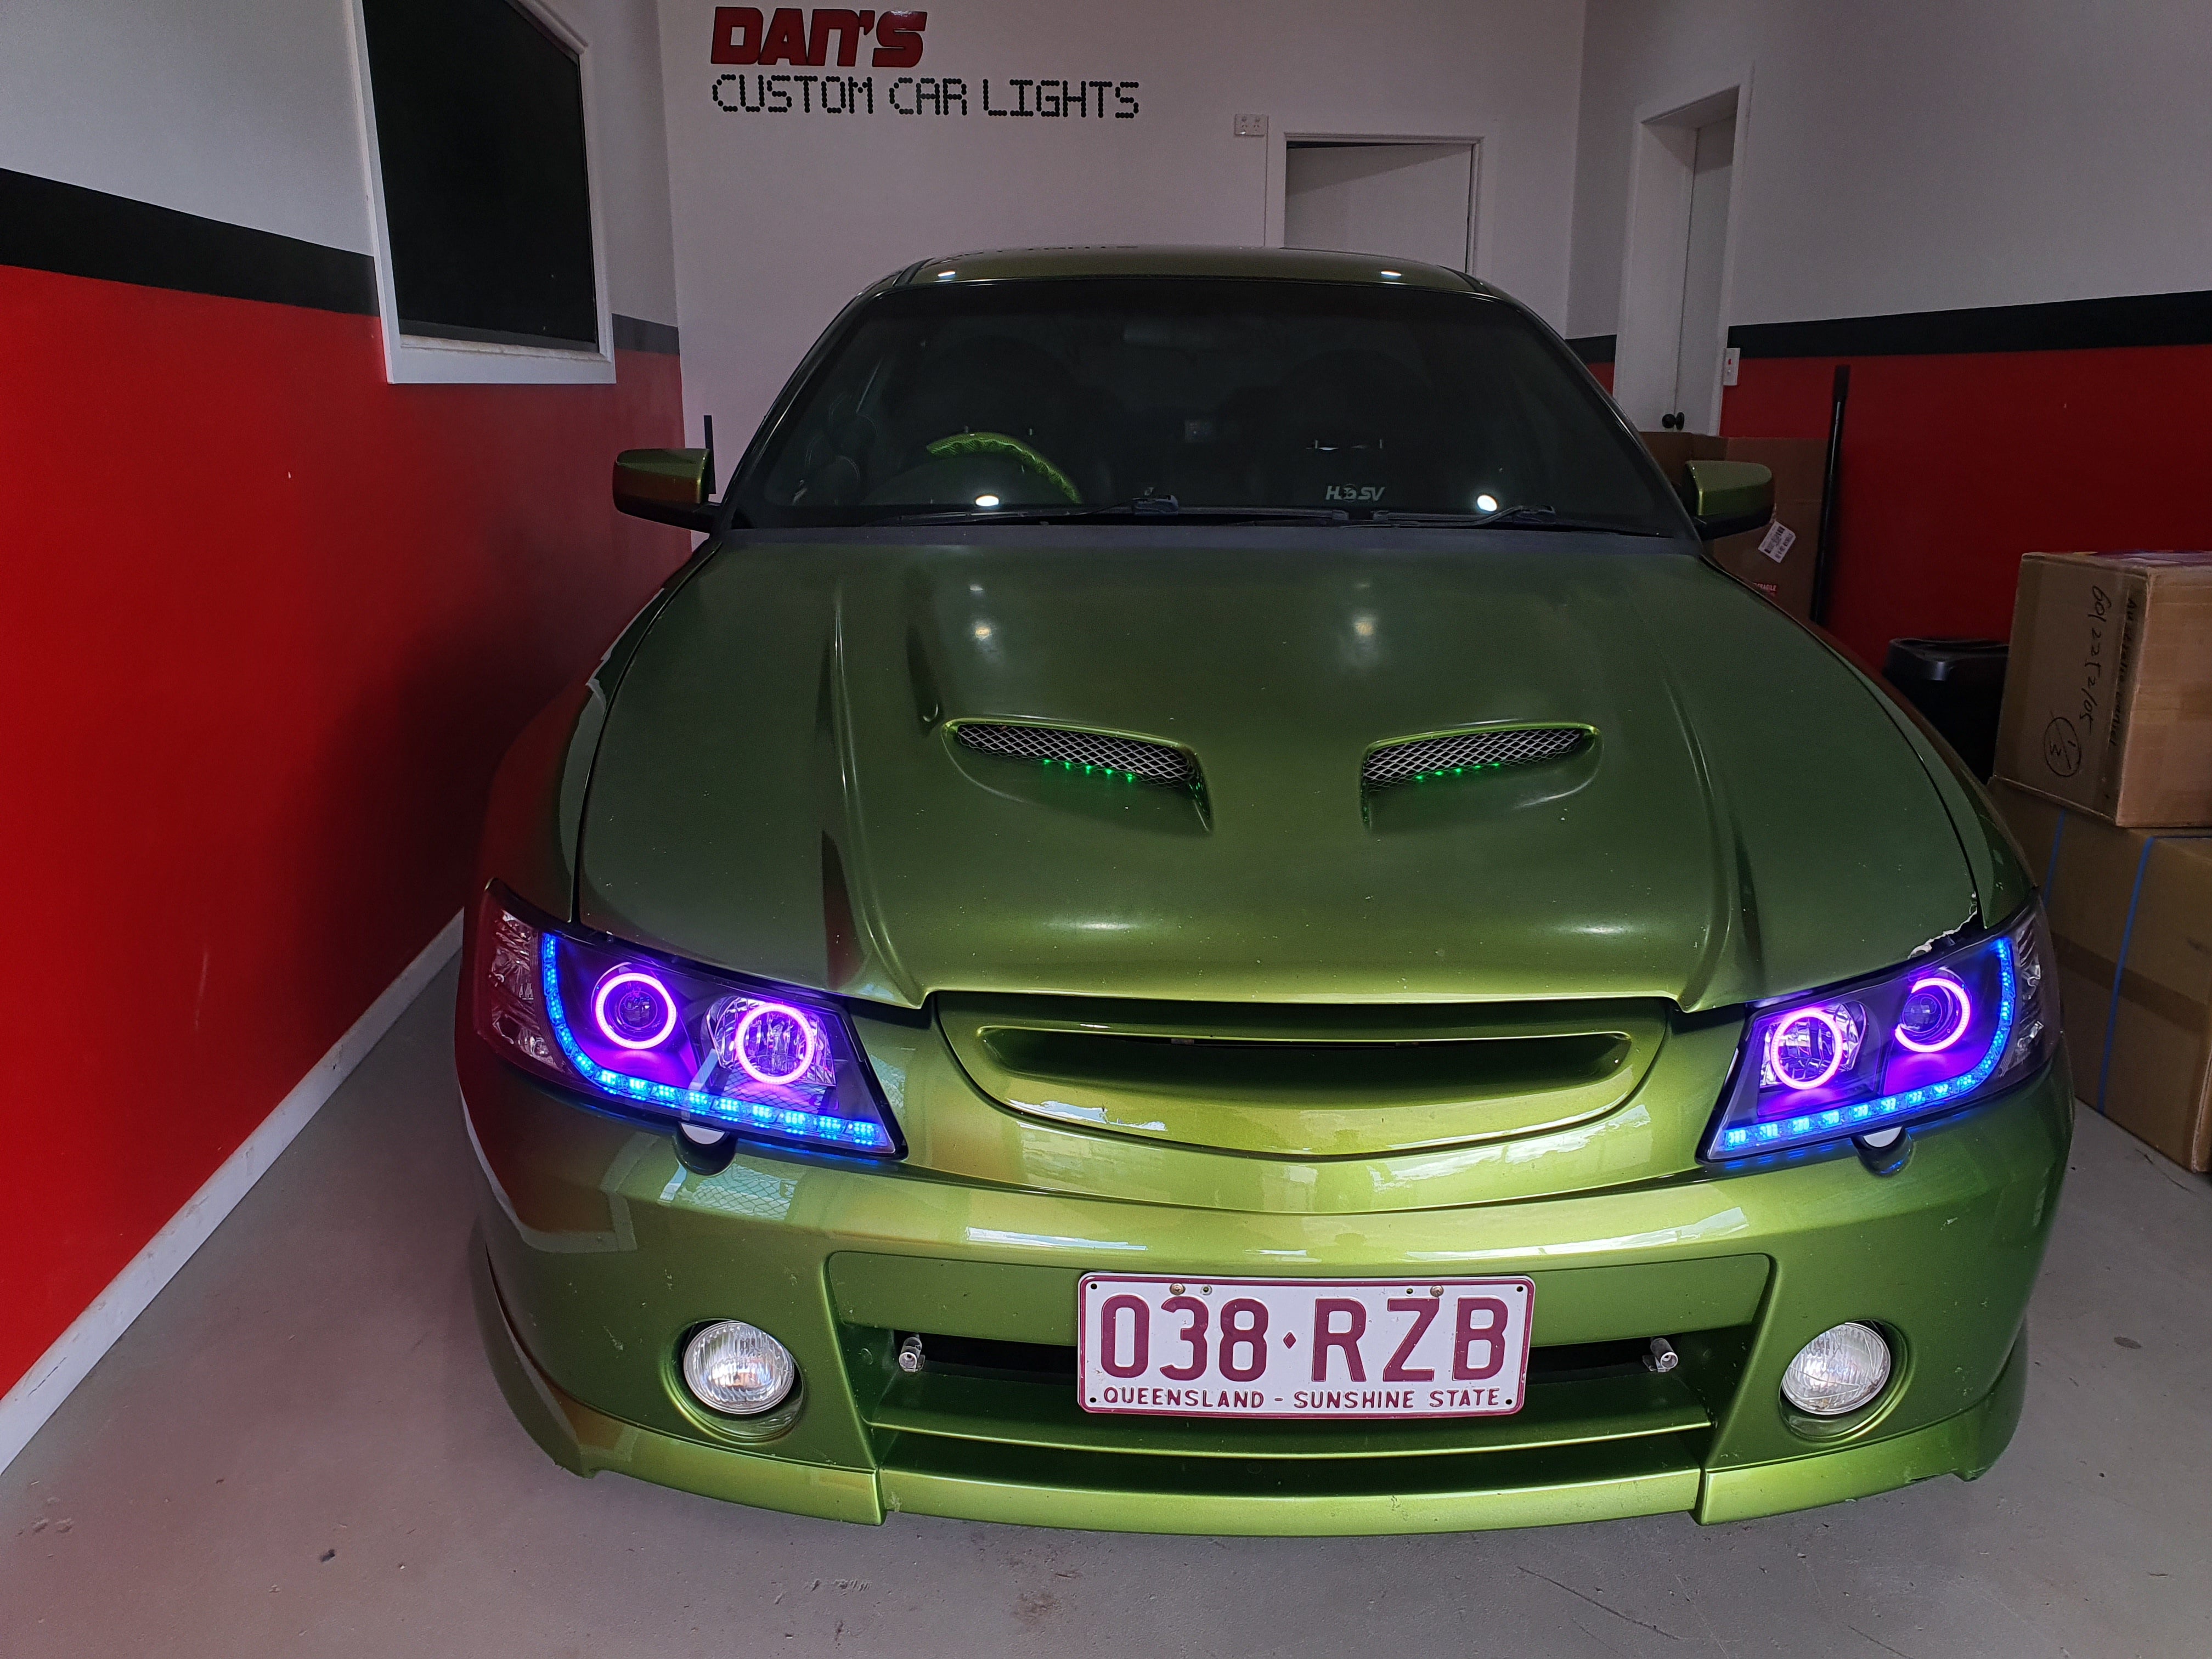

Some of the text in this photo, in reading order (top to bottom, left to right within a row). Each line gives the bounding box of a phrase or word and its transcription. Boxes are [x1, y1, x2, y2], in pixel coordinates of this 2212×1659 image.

[712, 74, 1139, 119] CUSTOM CAR LIGHTS
[1104, 1387, 1264, 1408] QUEENSLAND
[1294, 1390, 1415, 1409] SUNSHINE
[1429, 1388, 1500, 1408] STATE
